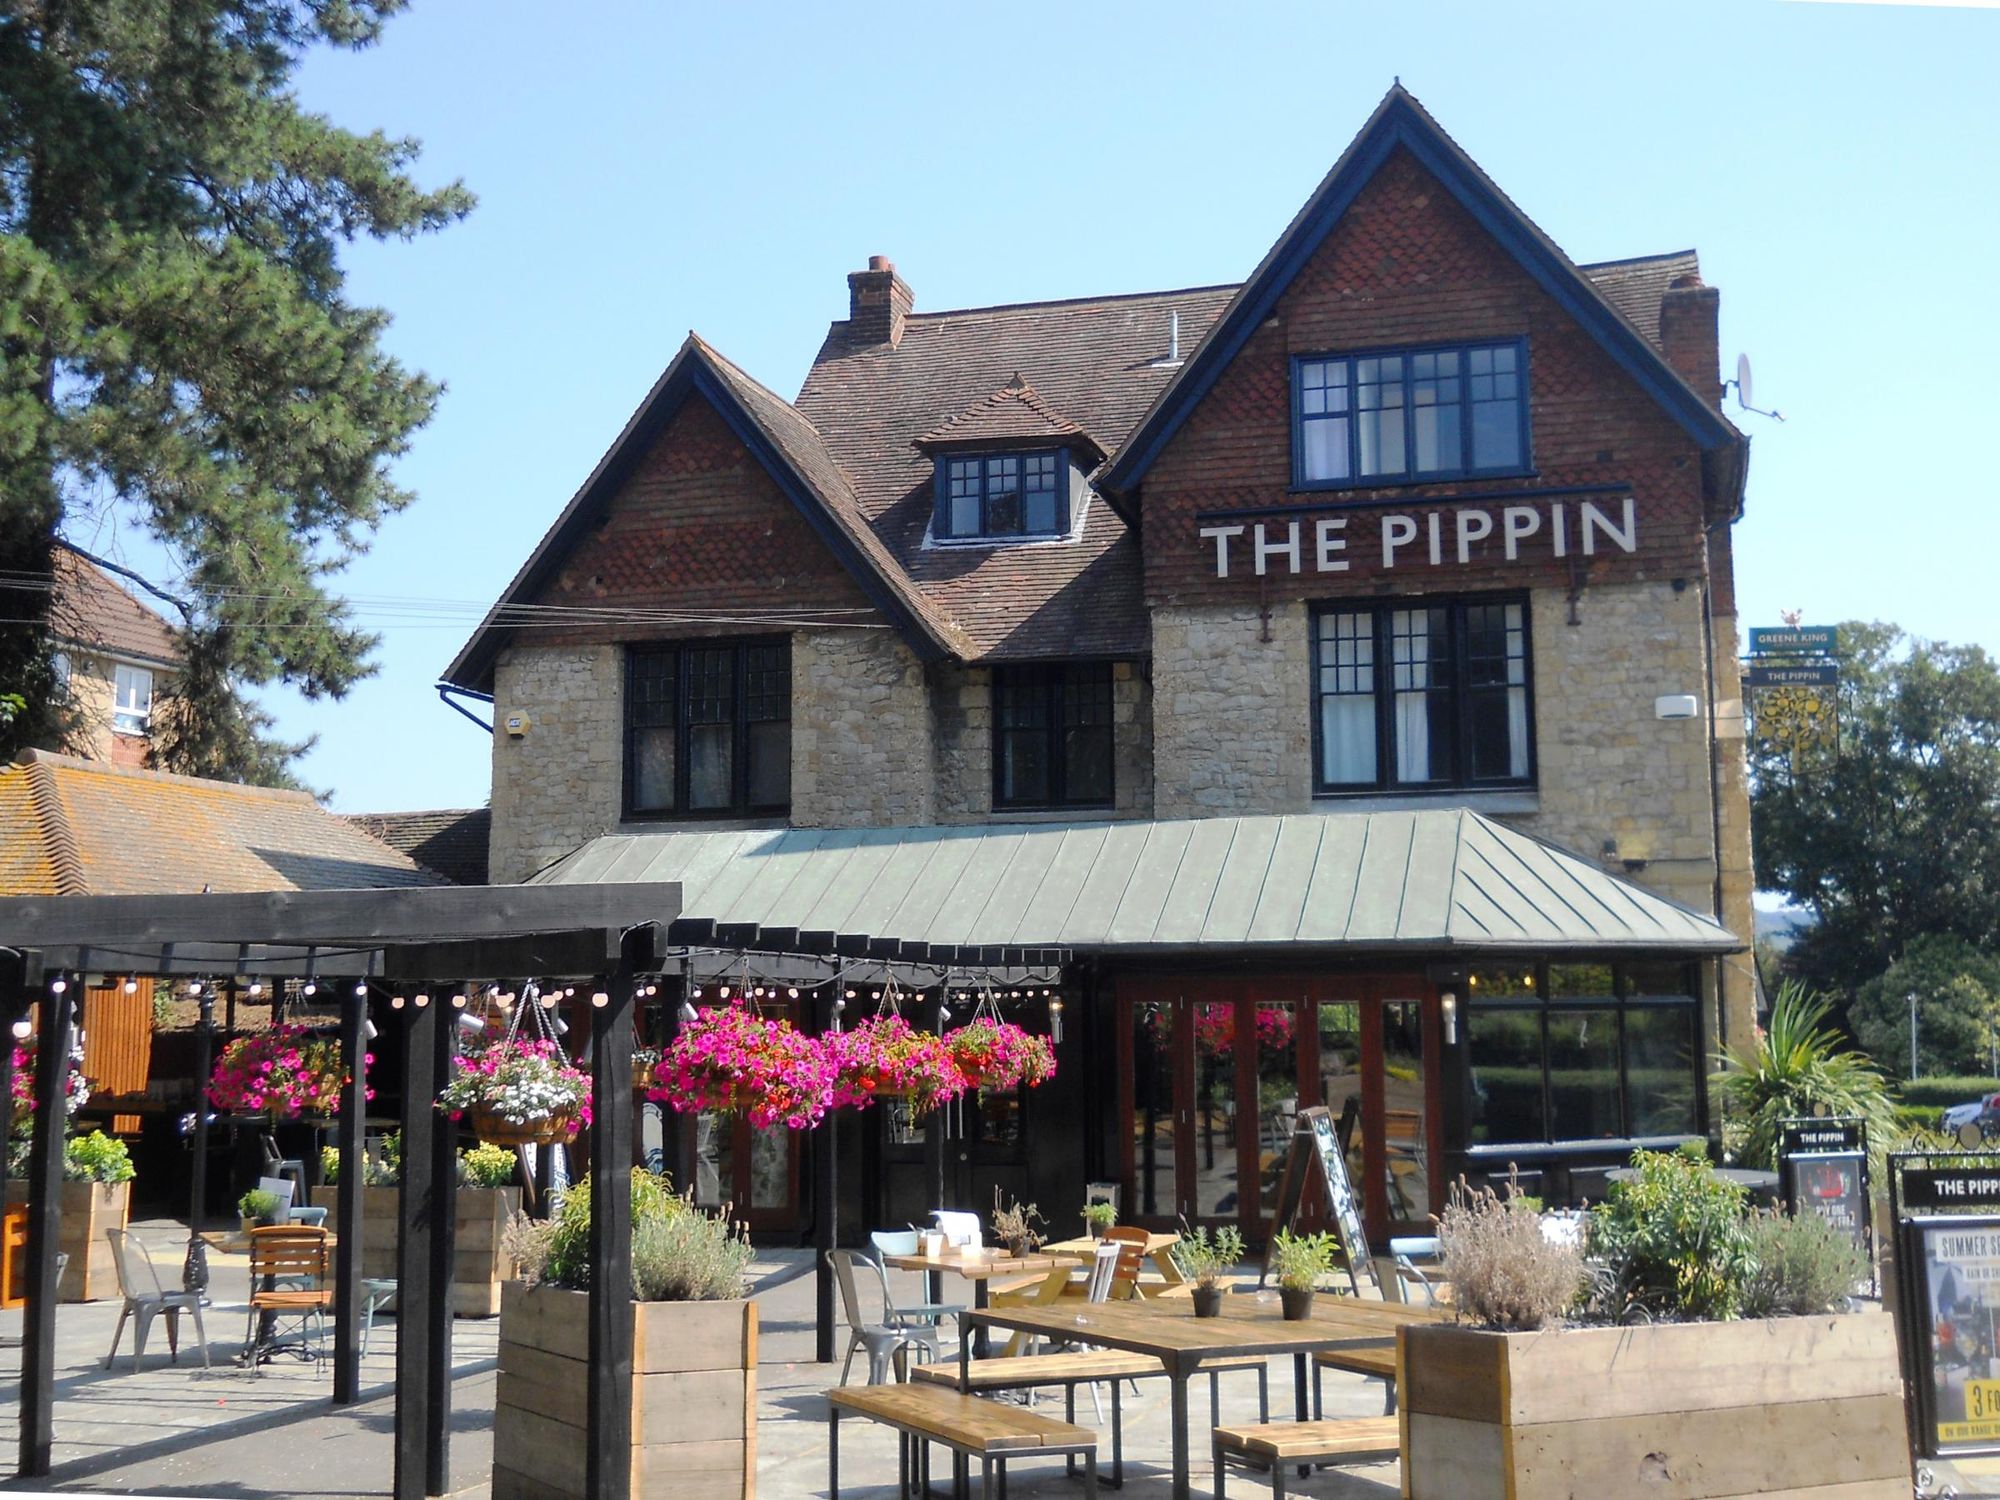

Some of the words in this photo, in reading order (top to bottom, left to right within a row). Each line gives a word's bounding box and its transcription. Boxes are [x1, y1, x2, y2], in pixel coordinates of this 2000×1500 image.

[1200, 519, 1350, 578] THE
[1381, 498, 1637, 569] PIPPIN
[1758, 634, 1797, 644] GREENE
[1801, 633, 1828, 642] KING
[1767, 673, 1787, 681] THE
[1788, 672, 1820, 680] PIPPIN
[1800, 1133, 1817, 1143] THE
[1818, 1132, 1845, 1142] PIPPIN
[1934, 1180, 1965, 1195] THE
[1941, 1236, 1988, 1258] SUMMER
[1973, 1385, 1983, 1417] 3
